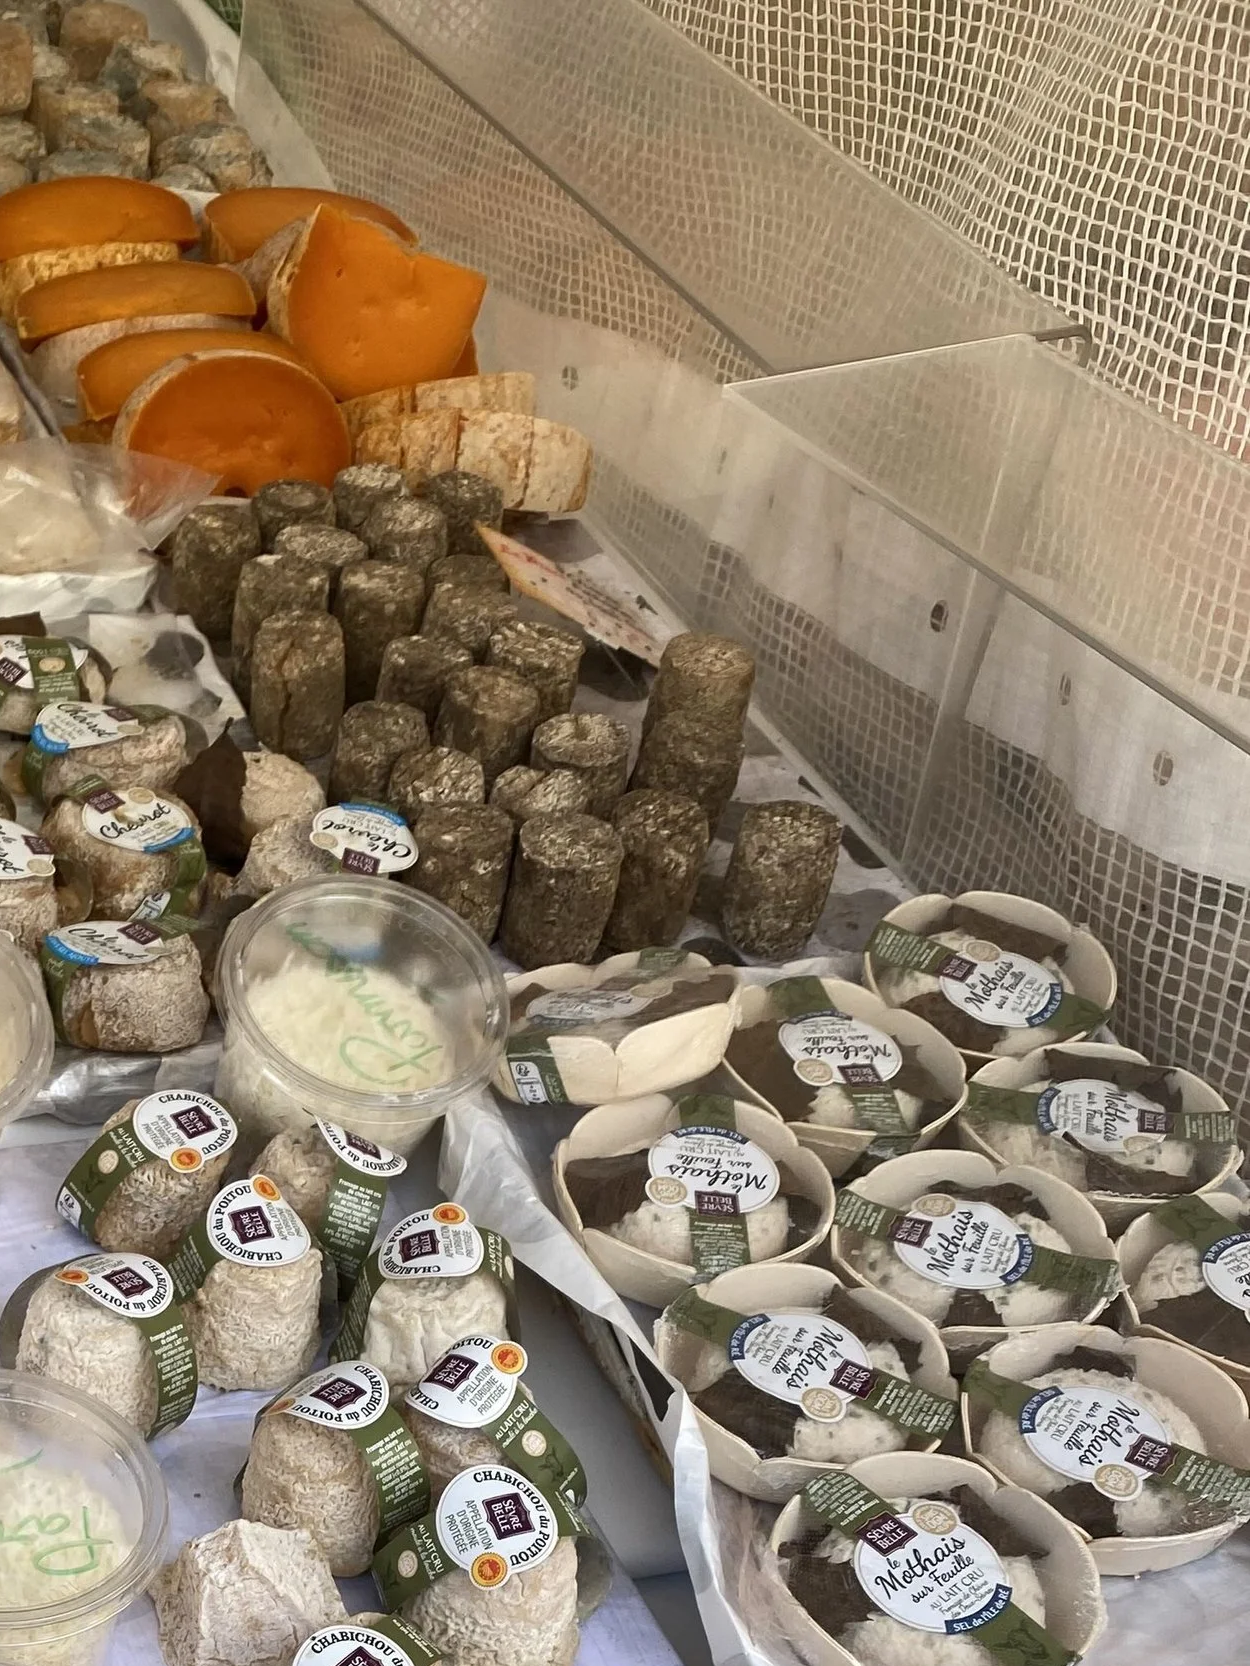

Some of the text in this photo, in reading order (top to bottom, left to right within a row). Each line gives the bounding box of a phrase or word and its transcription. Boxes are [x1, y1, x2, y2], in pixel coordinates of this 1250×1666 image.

[964, 960, 1014, 1012] Mothais
[159, 1093, 224, 1117] CHABICHOU
[202, 1129, 231, 1155] POITOU
[665, 1164, 768, 1190] Mothais
[215, 1185, 251, 1216] POITOU
[216, 1232, 282, 1260] CHABICHOU
[927, 1209, 974, 1277] Mothais
[786, 1325, 843, 1389] Mothais
[1079, 1400, 1140, 1467] Mothais
[465, 1499, 494, 1551] APPELLATION
[473, 1470, 551, 1567] CHABICHOU du POITOU
[491, 1502, 511, 1533] BELLE
[502, 1499, 523, 1531] SÈVRE
[866, 1519, 899, 1542] SÈVRE
[877, 1528, 907, 1549] BELLE
[875, 1537, 966, 1600] Mothais
[887, 1557, 900, 1570] le
[911, 1554, 974, 1603] sur Feuille
[943, 1584, 961, 1602] LAIT
[961, 1568, 984, 1587] CRU
[311, 1631, 394, 1657] CHABICHOU
